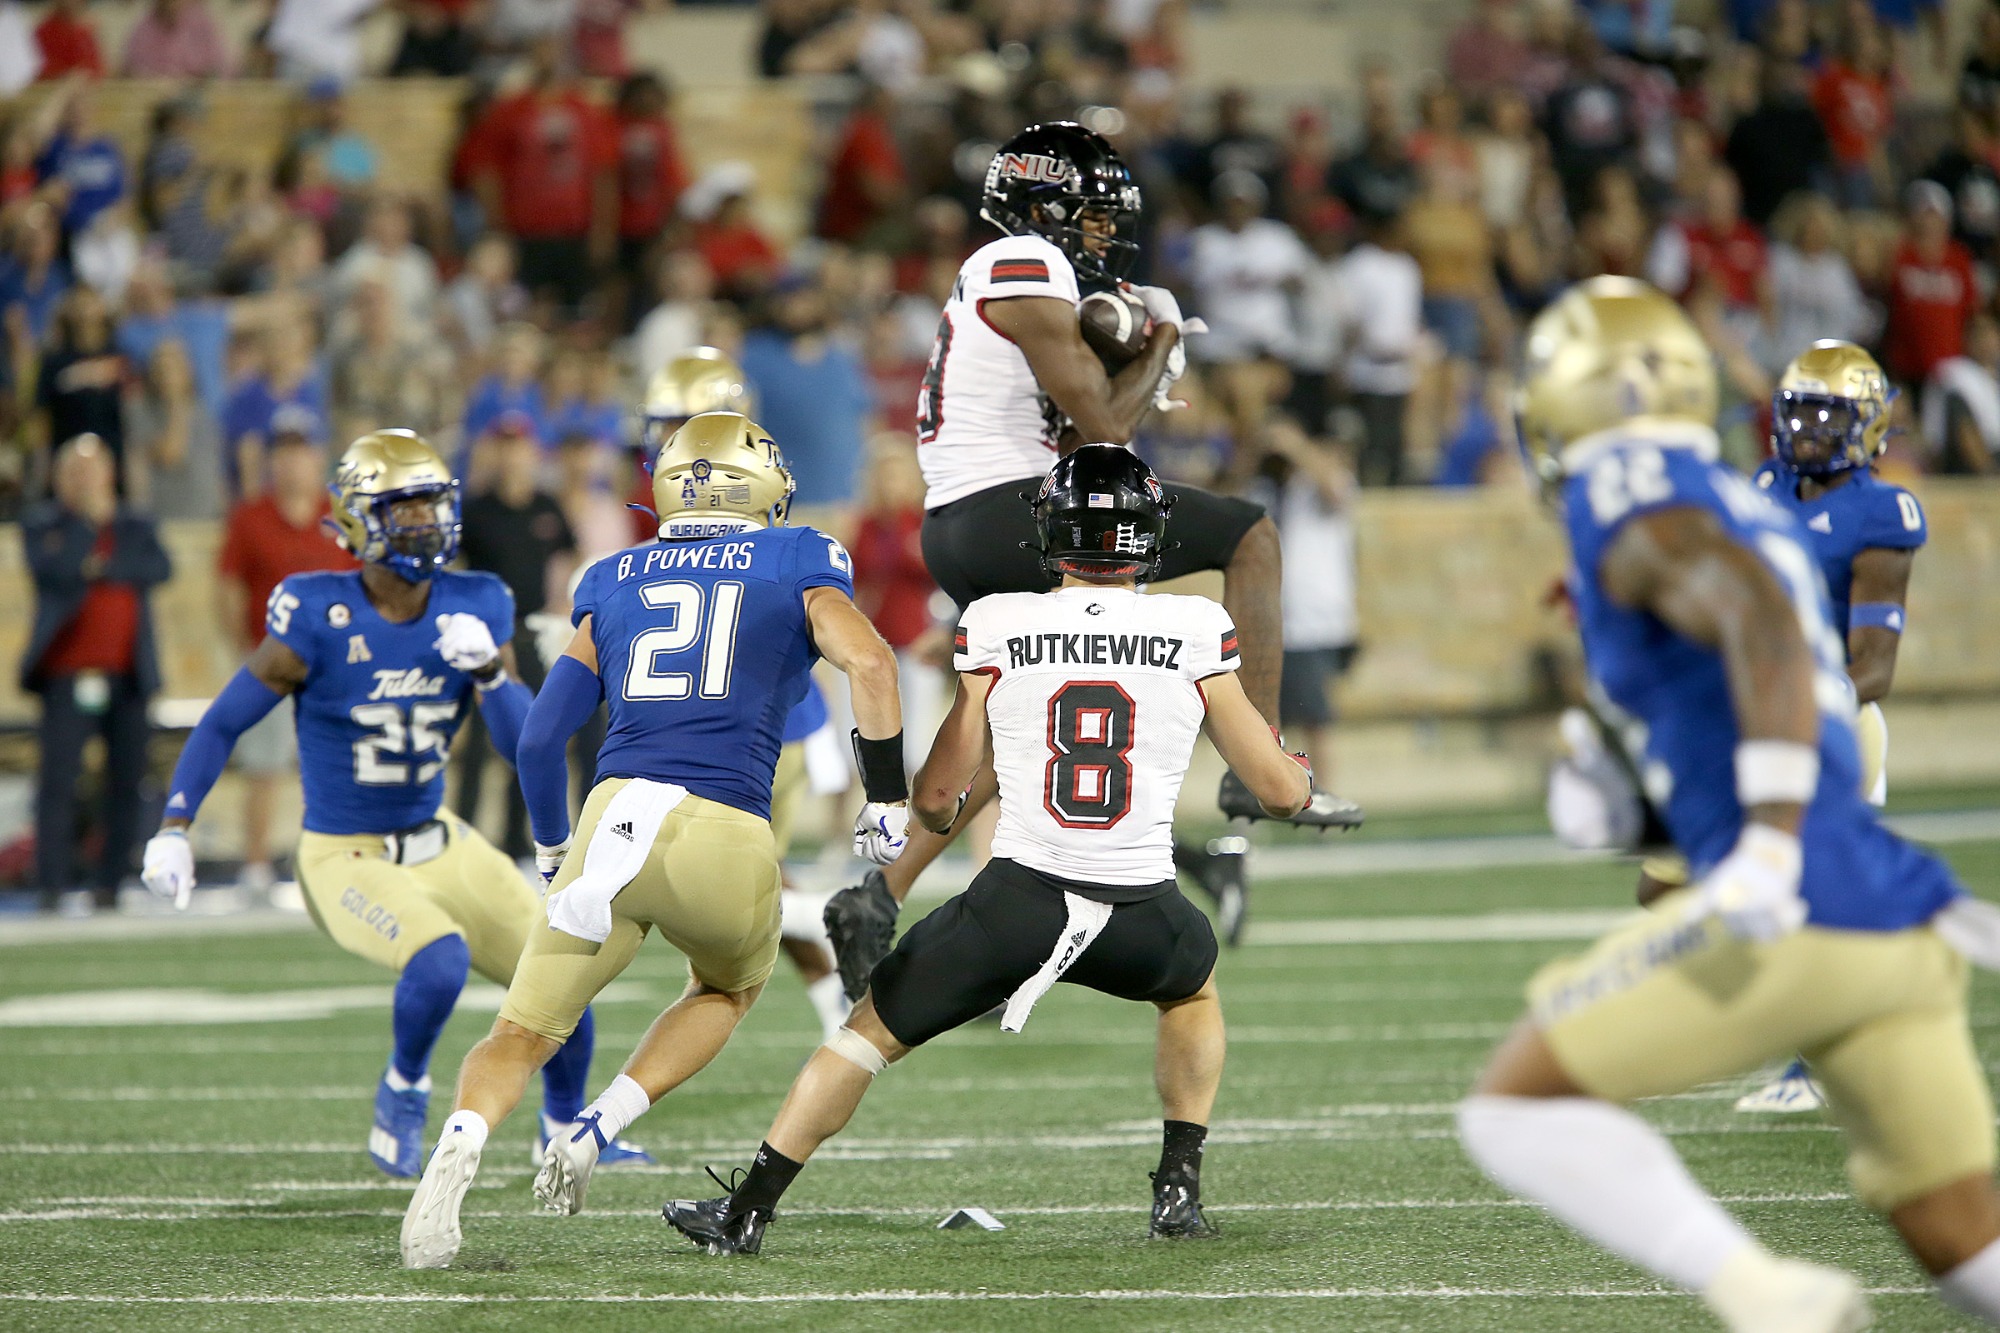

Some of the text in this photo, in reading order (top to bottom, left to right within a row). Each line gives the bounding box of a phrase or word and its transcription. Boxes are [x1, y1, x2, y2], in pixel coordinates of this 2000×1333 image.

[1000, 153, 1068, 184] NIU
[710, 494, 721, 507] 21
[1103, 530, 1116, 551] 8
[617, 541, 755, 582] B. POWERS
[1058, 561, 1078, 572] THE
[622, 579, 745, 702] 21
[1006, 633, 1184, 671] RUTKIEWICZ
[367, 667, 447, 700] Tulsa
[350, 700, 460, 787] 25
[1043, 680, 1137, 831] 8
[610, 827, 635, 843] adidas
[340, 886, 400, 941] GOLDEN
